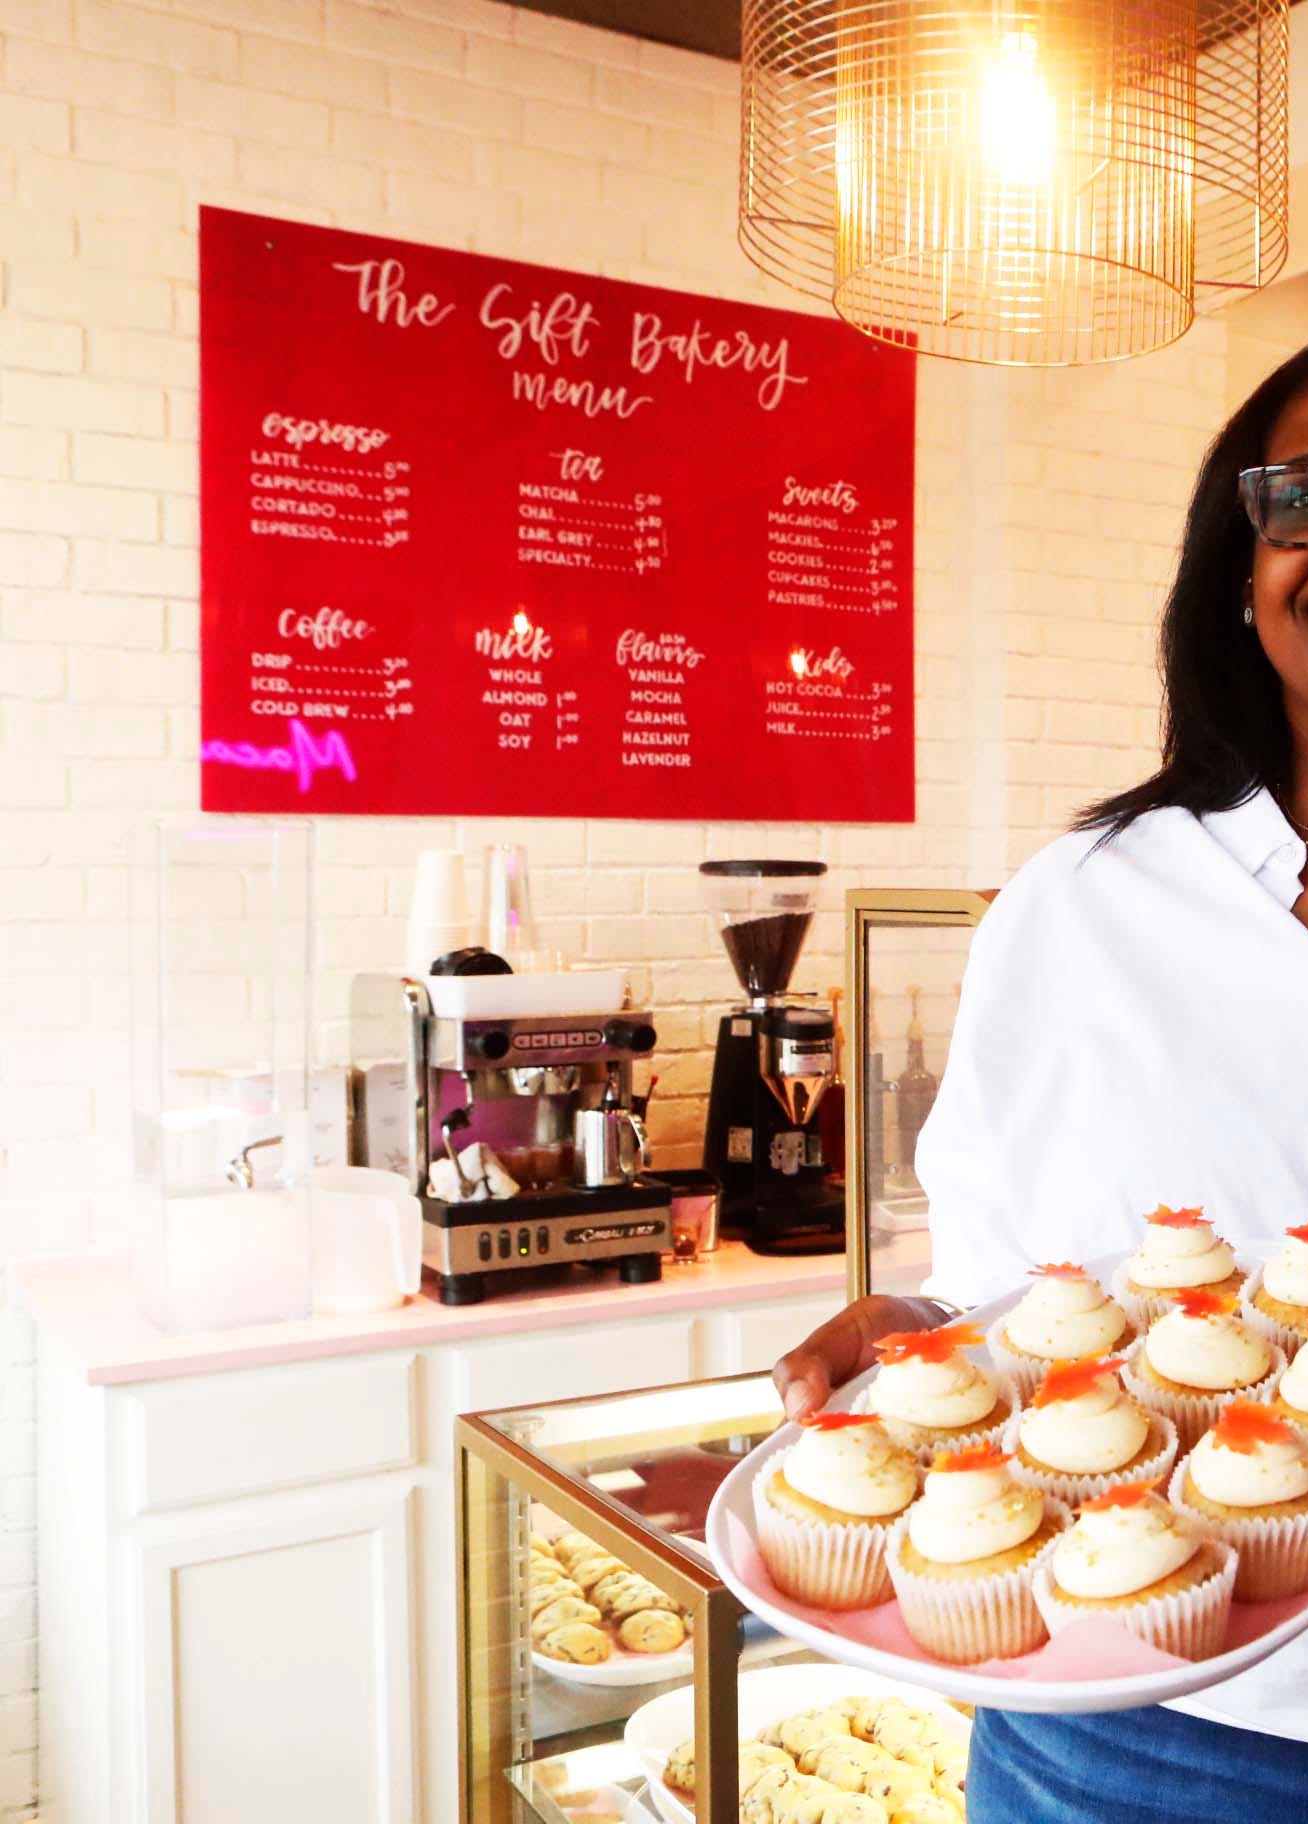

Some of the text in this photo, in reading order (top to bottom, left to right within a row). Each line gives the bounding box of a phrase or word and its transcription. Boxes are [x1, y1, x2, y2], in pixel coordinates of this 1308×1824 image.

[332, 258, 808, 410] The Gift Bakery
[513, 369, 654, 418] menu
[251, 450, 300, 468] LATTE
[549, 448, 604, 481] tea
[251, 473, 360, 496] CAPPUCCINO
[519, 484, 579, 503] MATCHA
[782, 476, 858, 514] Sweets
[251, 496, 336, 518] CORTADO
[519, 504, 555, 520] CHAI
[768, 512, 838, 530] MACARONS
[251, 520, 333, 541] ESPRESSO
[519, 526, 553, 542] EARL
[557, 530, 592, 546] GREY
[518, 548, 591, 566] SPECIALTY
[768, 551, 824, 568] COOKIES
[768, 570, 830, 588] CUPCAKES
[768, 590, 824, 607] PASTRIES
[278, 607, 376, 649] Coffee
[475, 624, 553, 662] milk
[251, 653, 292, 669] DRIP
[252, 677, 290, 693] ICED
[489, 669, 541, 684] WHOLE
[629, 669, 684, 684] VANILLA
[631, 690, 681, 704] MOCHA
[766, 681, 793, 695] HOT
[796, 683, 842, 697] COCOA
[482, 691, 547, 706] ALMOND
[251, 700, 299, 715] COLD
[303, 703, 349, 717] BREW
[766, 702, 799, 715] JUICE
[499, 712, 531, 727] OAT
[626, 710, 686, 725] CARAMEL
[767, 722, 796, 734] MILK
[499, 734, 531, 748] SOY
[623, 732, 689, 745] HAZELNUT
[622, 753, 690, 766] LAVENDER
